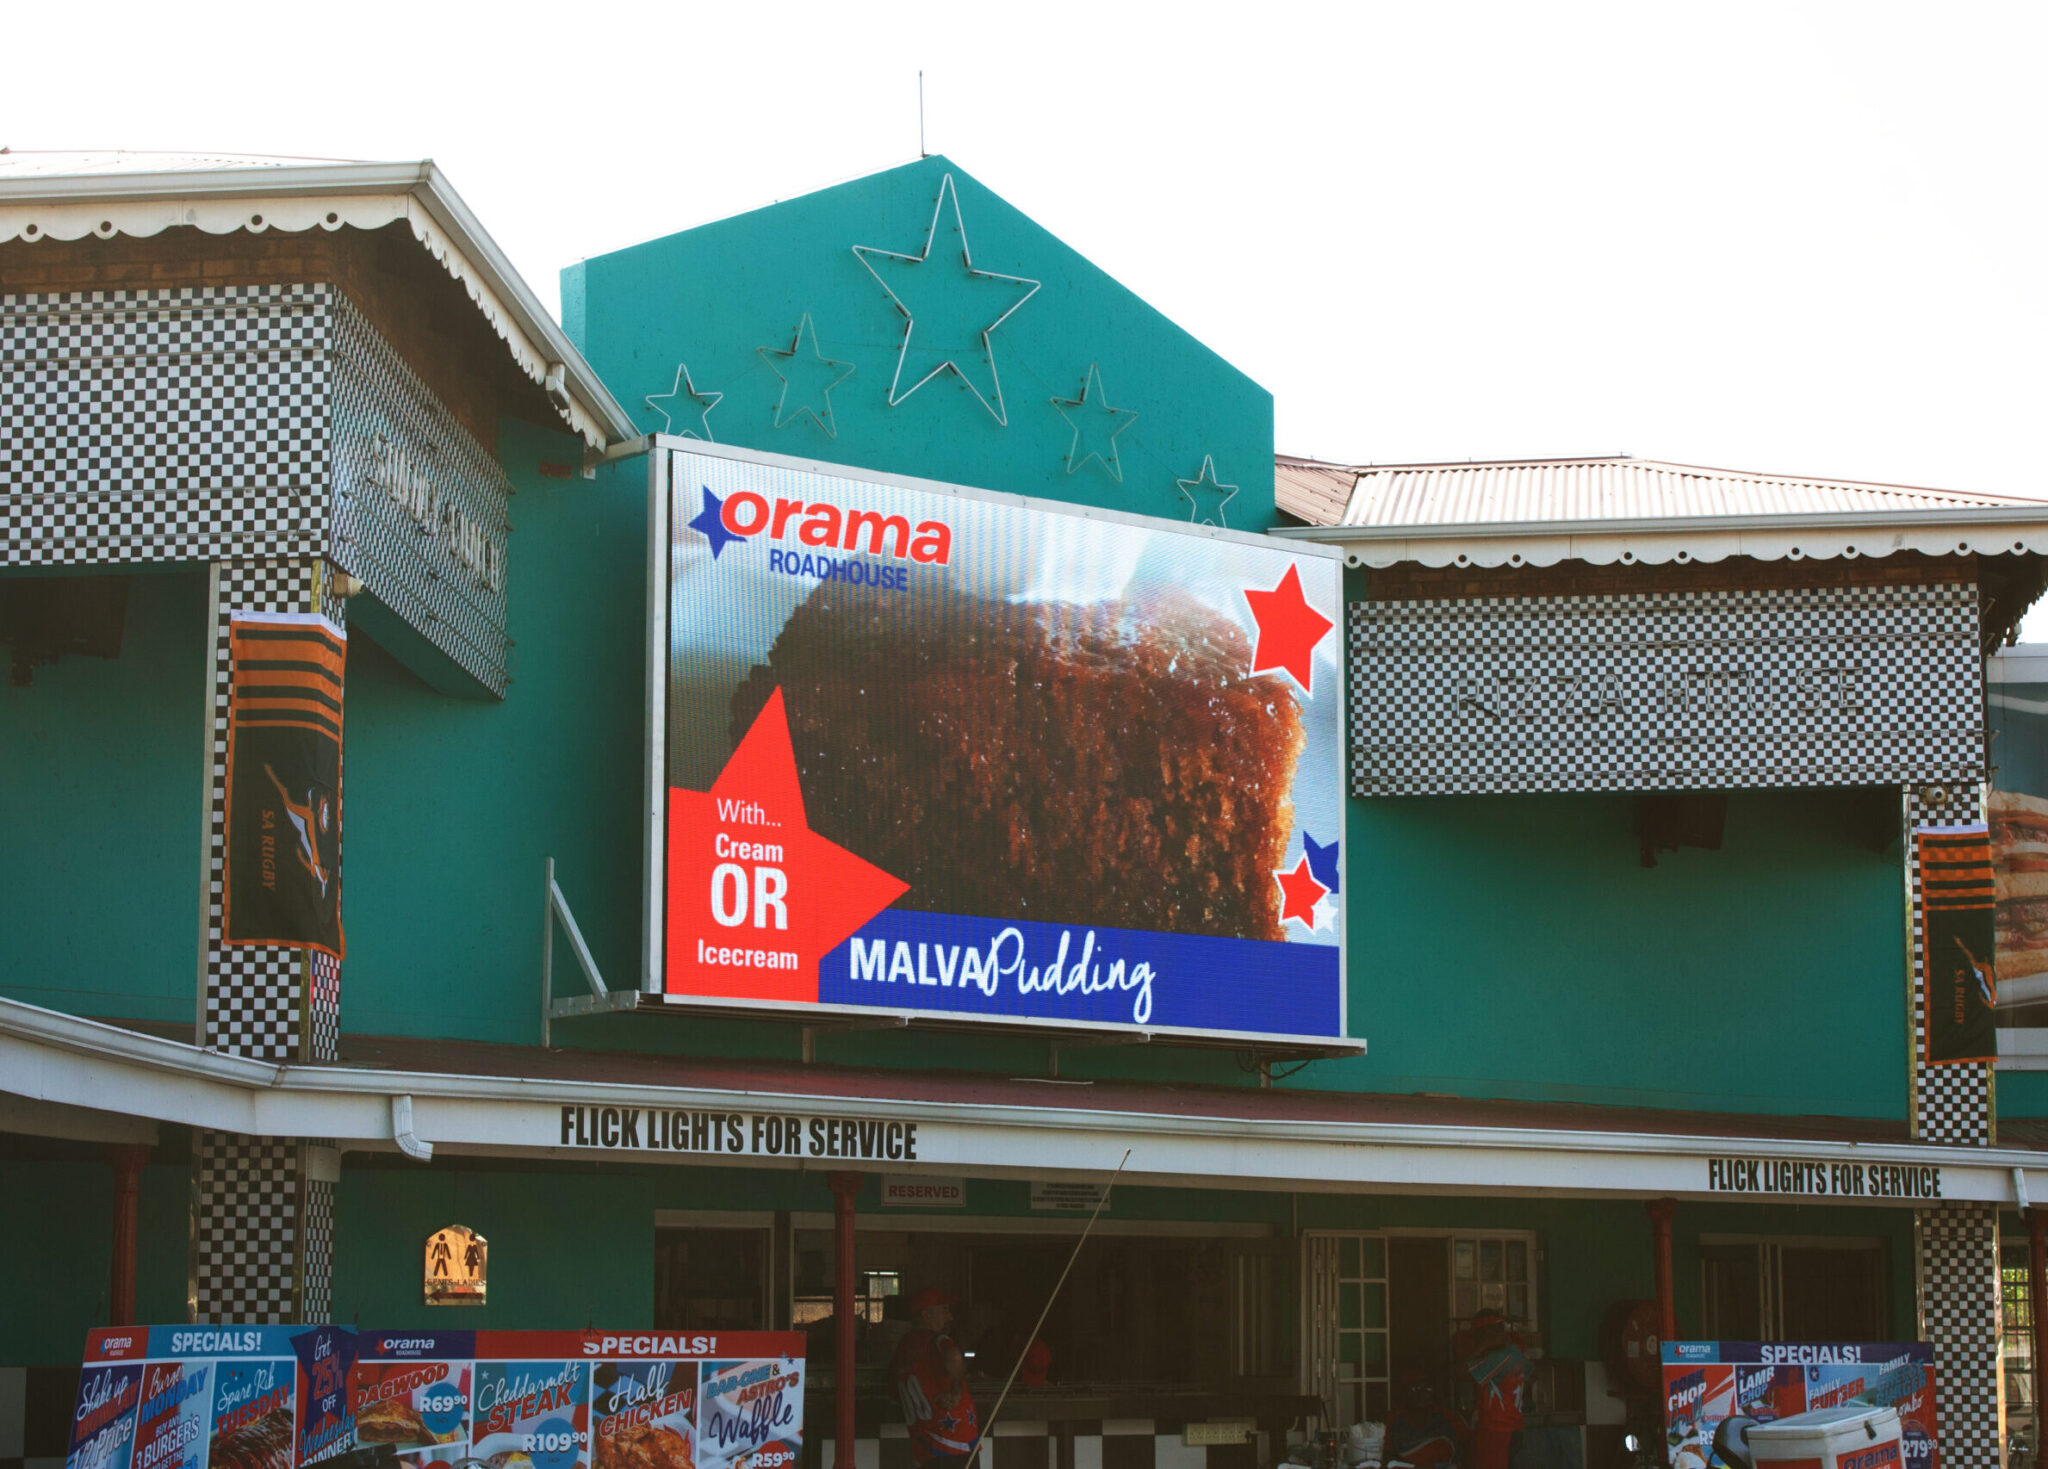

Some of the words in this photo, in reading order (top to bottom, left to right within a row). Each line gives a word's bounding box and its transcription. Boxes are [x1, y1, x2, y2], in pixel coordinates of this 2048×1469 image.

[720, 489, 952, 566] orama
[769, 548, 908, 592] ROADHOUSE
[1663, 666, 1863, 714] HOUSE
[261, 809, 275, 830] SA
[717, 797, 782, 828] With...
[261, 835, 276, 892] RUGBY
[715, 833, 784, 864] Cream
[710, 862, 789, 930] OR
[698, 939, 799, 970] Icecream
[849, 937, 984, 989] MALVA
[978, 926, 1155, 1023] Pudding
[561, 1106, 640, 1148] FLICK
[647, 1110, 744, 1153] LIGHTS
[752, 1115, 801, 1155] FOR
[808, 1118, 918, 1160] SERVICE
[888, 1185, 960, 1199] RESERVED
[1708, 1159, 1760, 1192] FLICK
[1764, 1161, 1827, 1194] LIGHTS
[1831, 1164, 1864, 1195] FOR
[1868, 1165, 1942, 1198] SERVICE
[104, 1337, 132, 1349] orama
[172, 1332, 262, 1353] SPECIALS!
[314, 1333, 332, 1361] Get
[383, 1338, 435, 1350] orama
[583, 1336, 717, 1356] SPECIALS!
[1679, 1345, 1711, 1354] orama
[1761, 1345, 1862, 1364] SPECIALS!
[312, 1351, 344, 1401] 25%
[772, 1364, 780, 1376] &
[1739, 1366, 1775, 1394] LAMB
[1879, 1352, 1911, 1376] FAMILY
[77, 1368, 112, 1421] Shake
[141, 1366, 209, 1427] MONDAY
[217, 1382, 253, 1412] Spare
[254, 1361, 275, 1391] Rib
[357, 1363, 450, 1407] DAGWOOD
[478, 1361, 582, 1413] Cheddarmelt
[609, 1362, 670, 1413] Half
[736, 1372, 800, 1405] ASTRO'S
[1668, 1381, 1707, 1412] CHOP
[1740, 1383, 1768, 1406] CHOP
[1809, 1377, 1841, 1399] FAMILY
[216, 1382, 292, 1437] TUESDAY
[322, 1394, 337, 1412] OFF
[487, 1383, 573, 1432] STEAK
[599, 1389, 693, 1438] CHICKEN
[1898, 1392, 1924, 1416] ombo
[709, 1391, 794, 1449] Waffle
[144, 1414, 200, 1468] BURGERS
